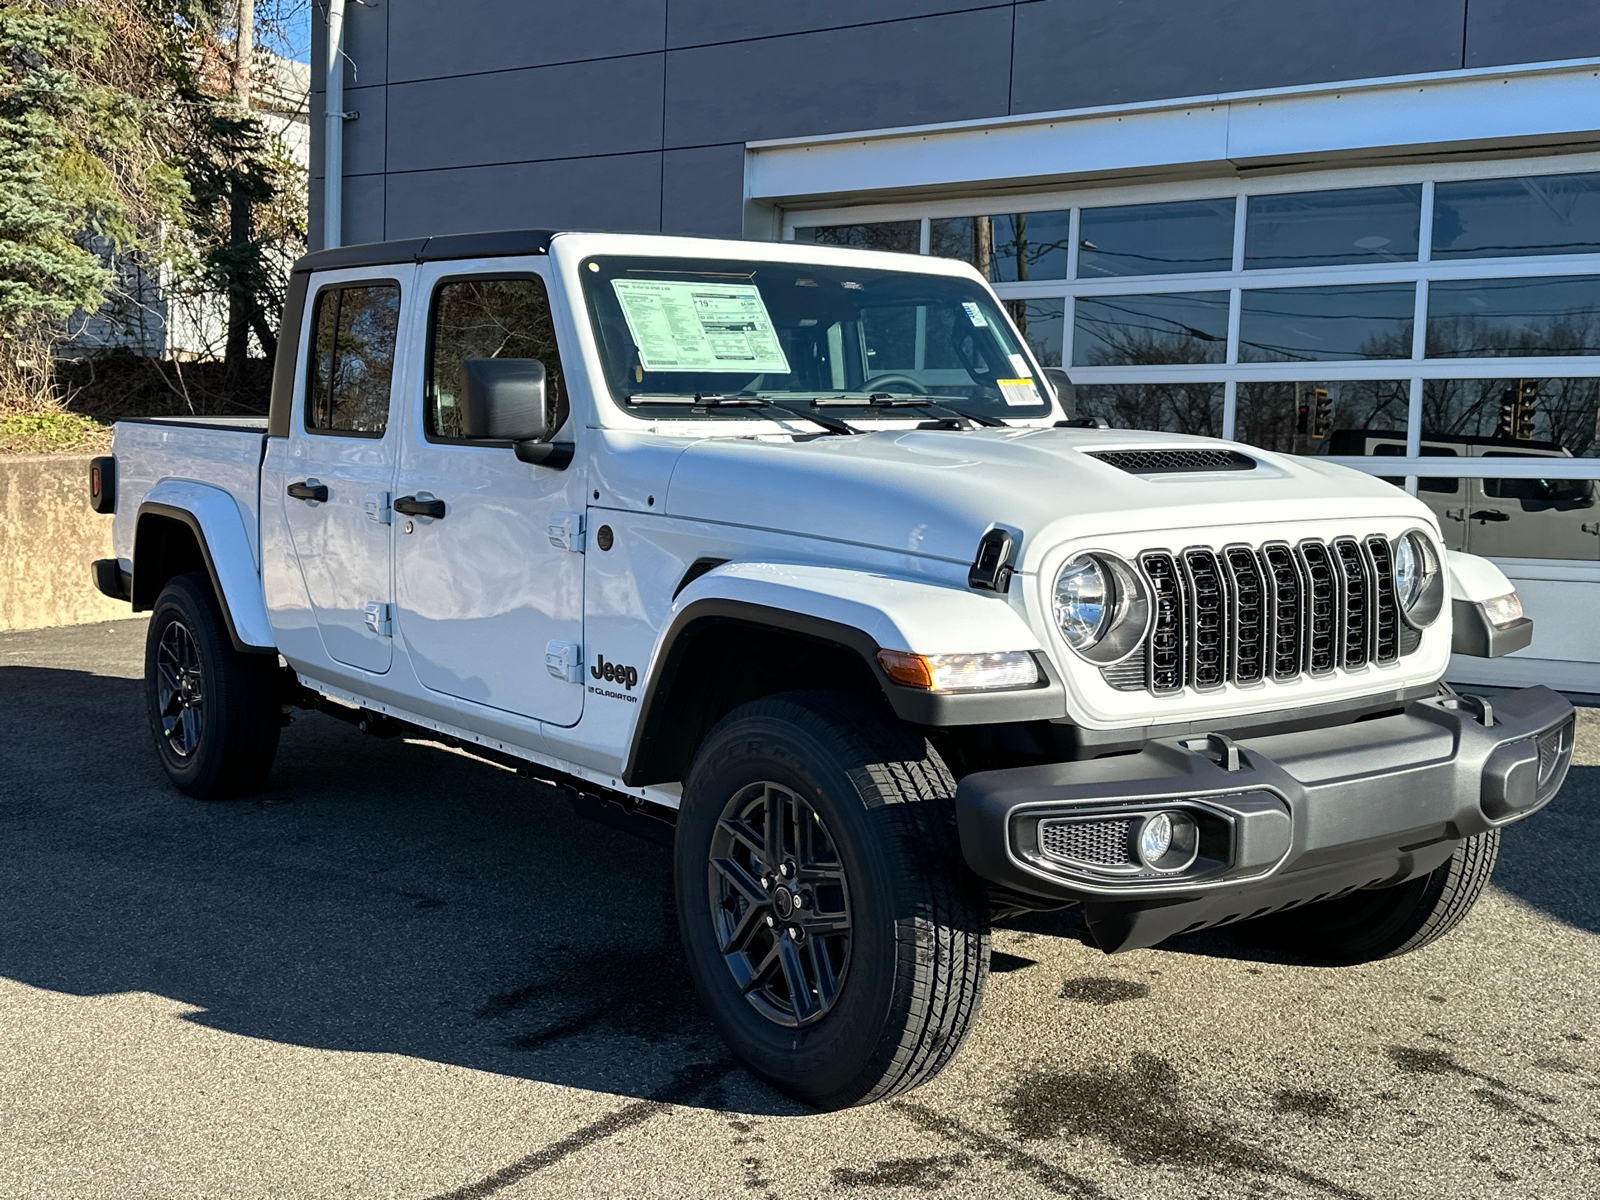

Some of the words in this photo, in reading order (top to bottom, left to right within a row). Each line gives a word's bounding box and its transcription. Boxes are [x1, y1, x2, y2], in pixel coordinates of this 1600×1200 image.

[698, 299, 709, 308] 19
[591, 654, 638, 691] Jeep
[594, 687, 638, 703] GLADIATOR
